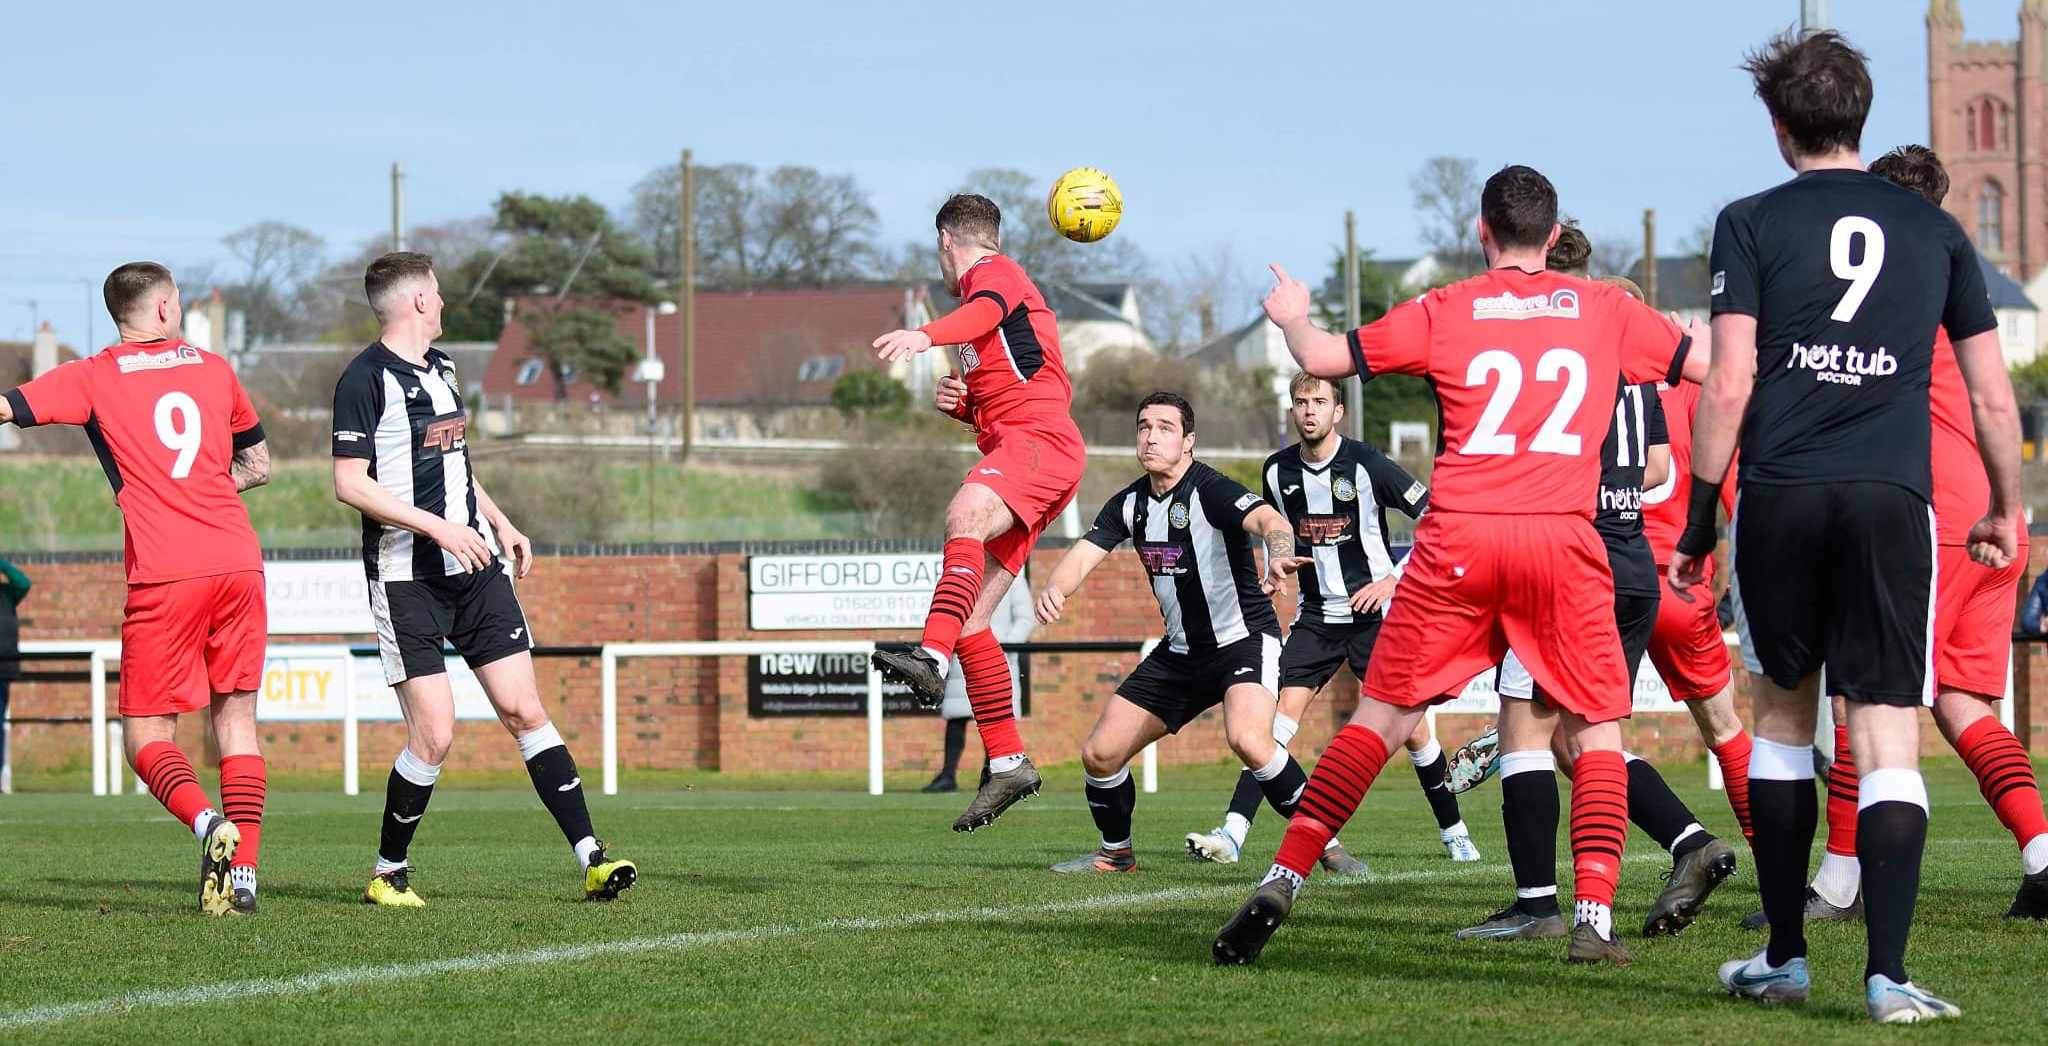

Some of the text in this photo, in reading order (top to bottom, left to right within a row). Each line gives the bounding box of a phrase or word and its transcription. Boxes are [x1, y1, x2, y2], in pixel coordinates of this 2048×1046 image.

[1829, 216, 1885, 322] 9
[1787, 342, 1898, 377] hot tub
[1816, 371, 1862, 386] DOCTOR
[1459, 347, 1588, 455] 22
[154, 391, 201, 479] 9
[1616, 384, 1646, 467] 11
[760, 562, 882, 587] GIFFORD
[760, 653, 866, 676] new(me
[265, 670, 332, 700] CITY
